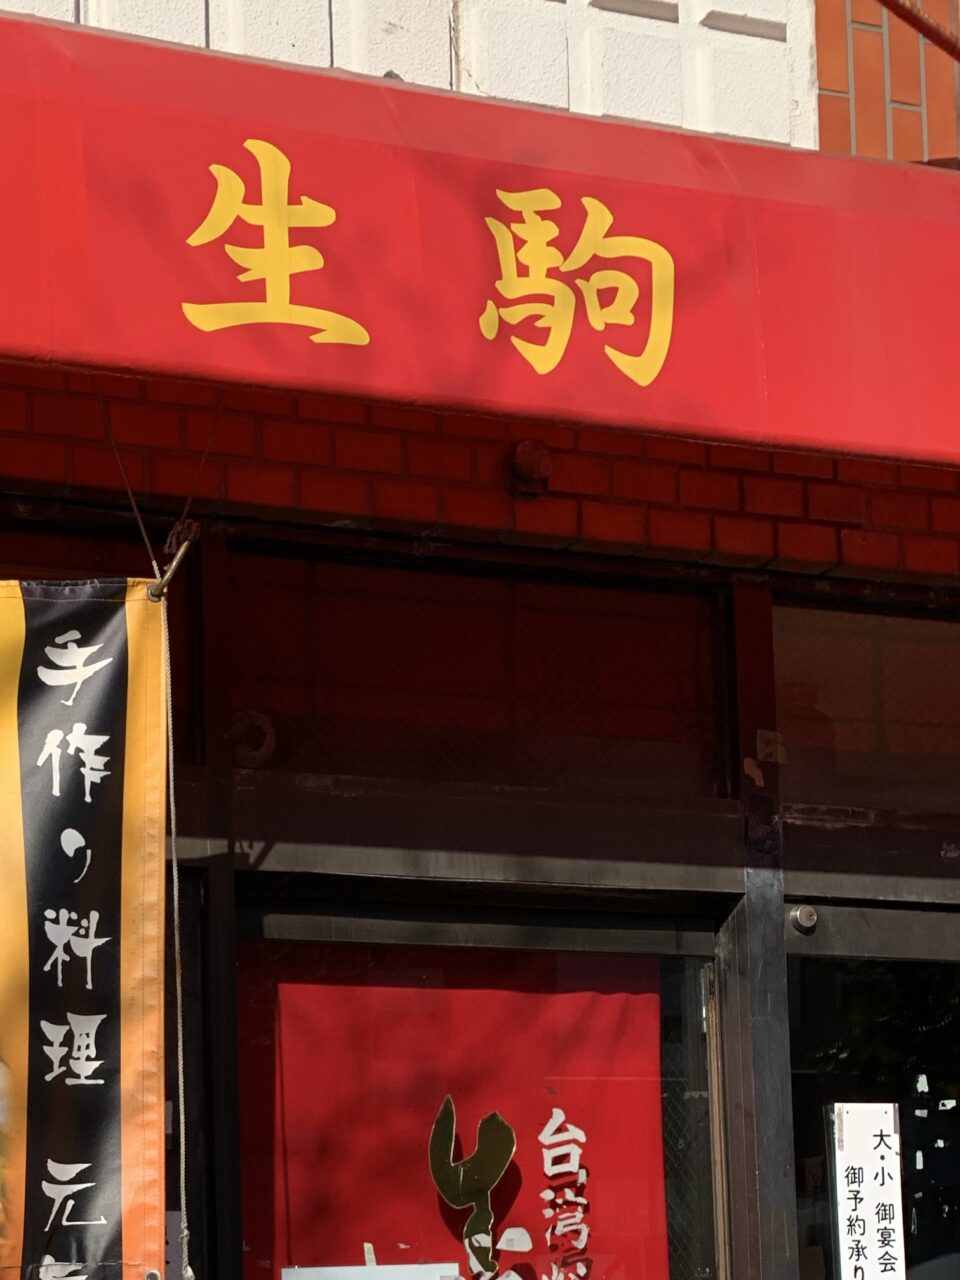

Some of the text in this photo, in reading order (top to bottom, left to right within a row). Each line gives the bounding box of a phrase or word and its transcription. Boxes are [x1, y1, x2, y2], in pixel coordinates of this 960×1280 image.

[181, 138, 676, 388] 生駒
[36, 629, 113, 1086] 手作り料理
[875, 1201, 898, 1274] 御宴会
